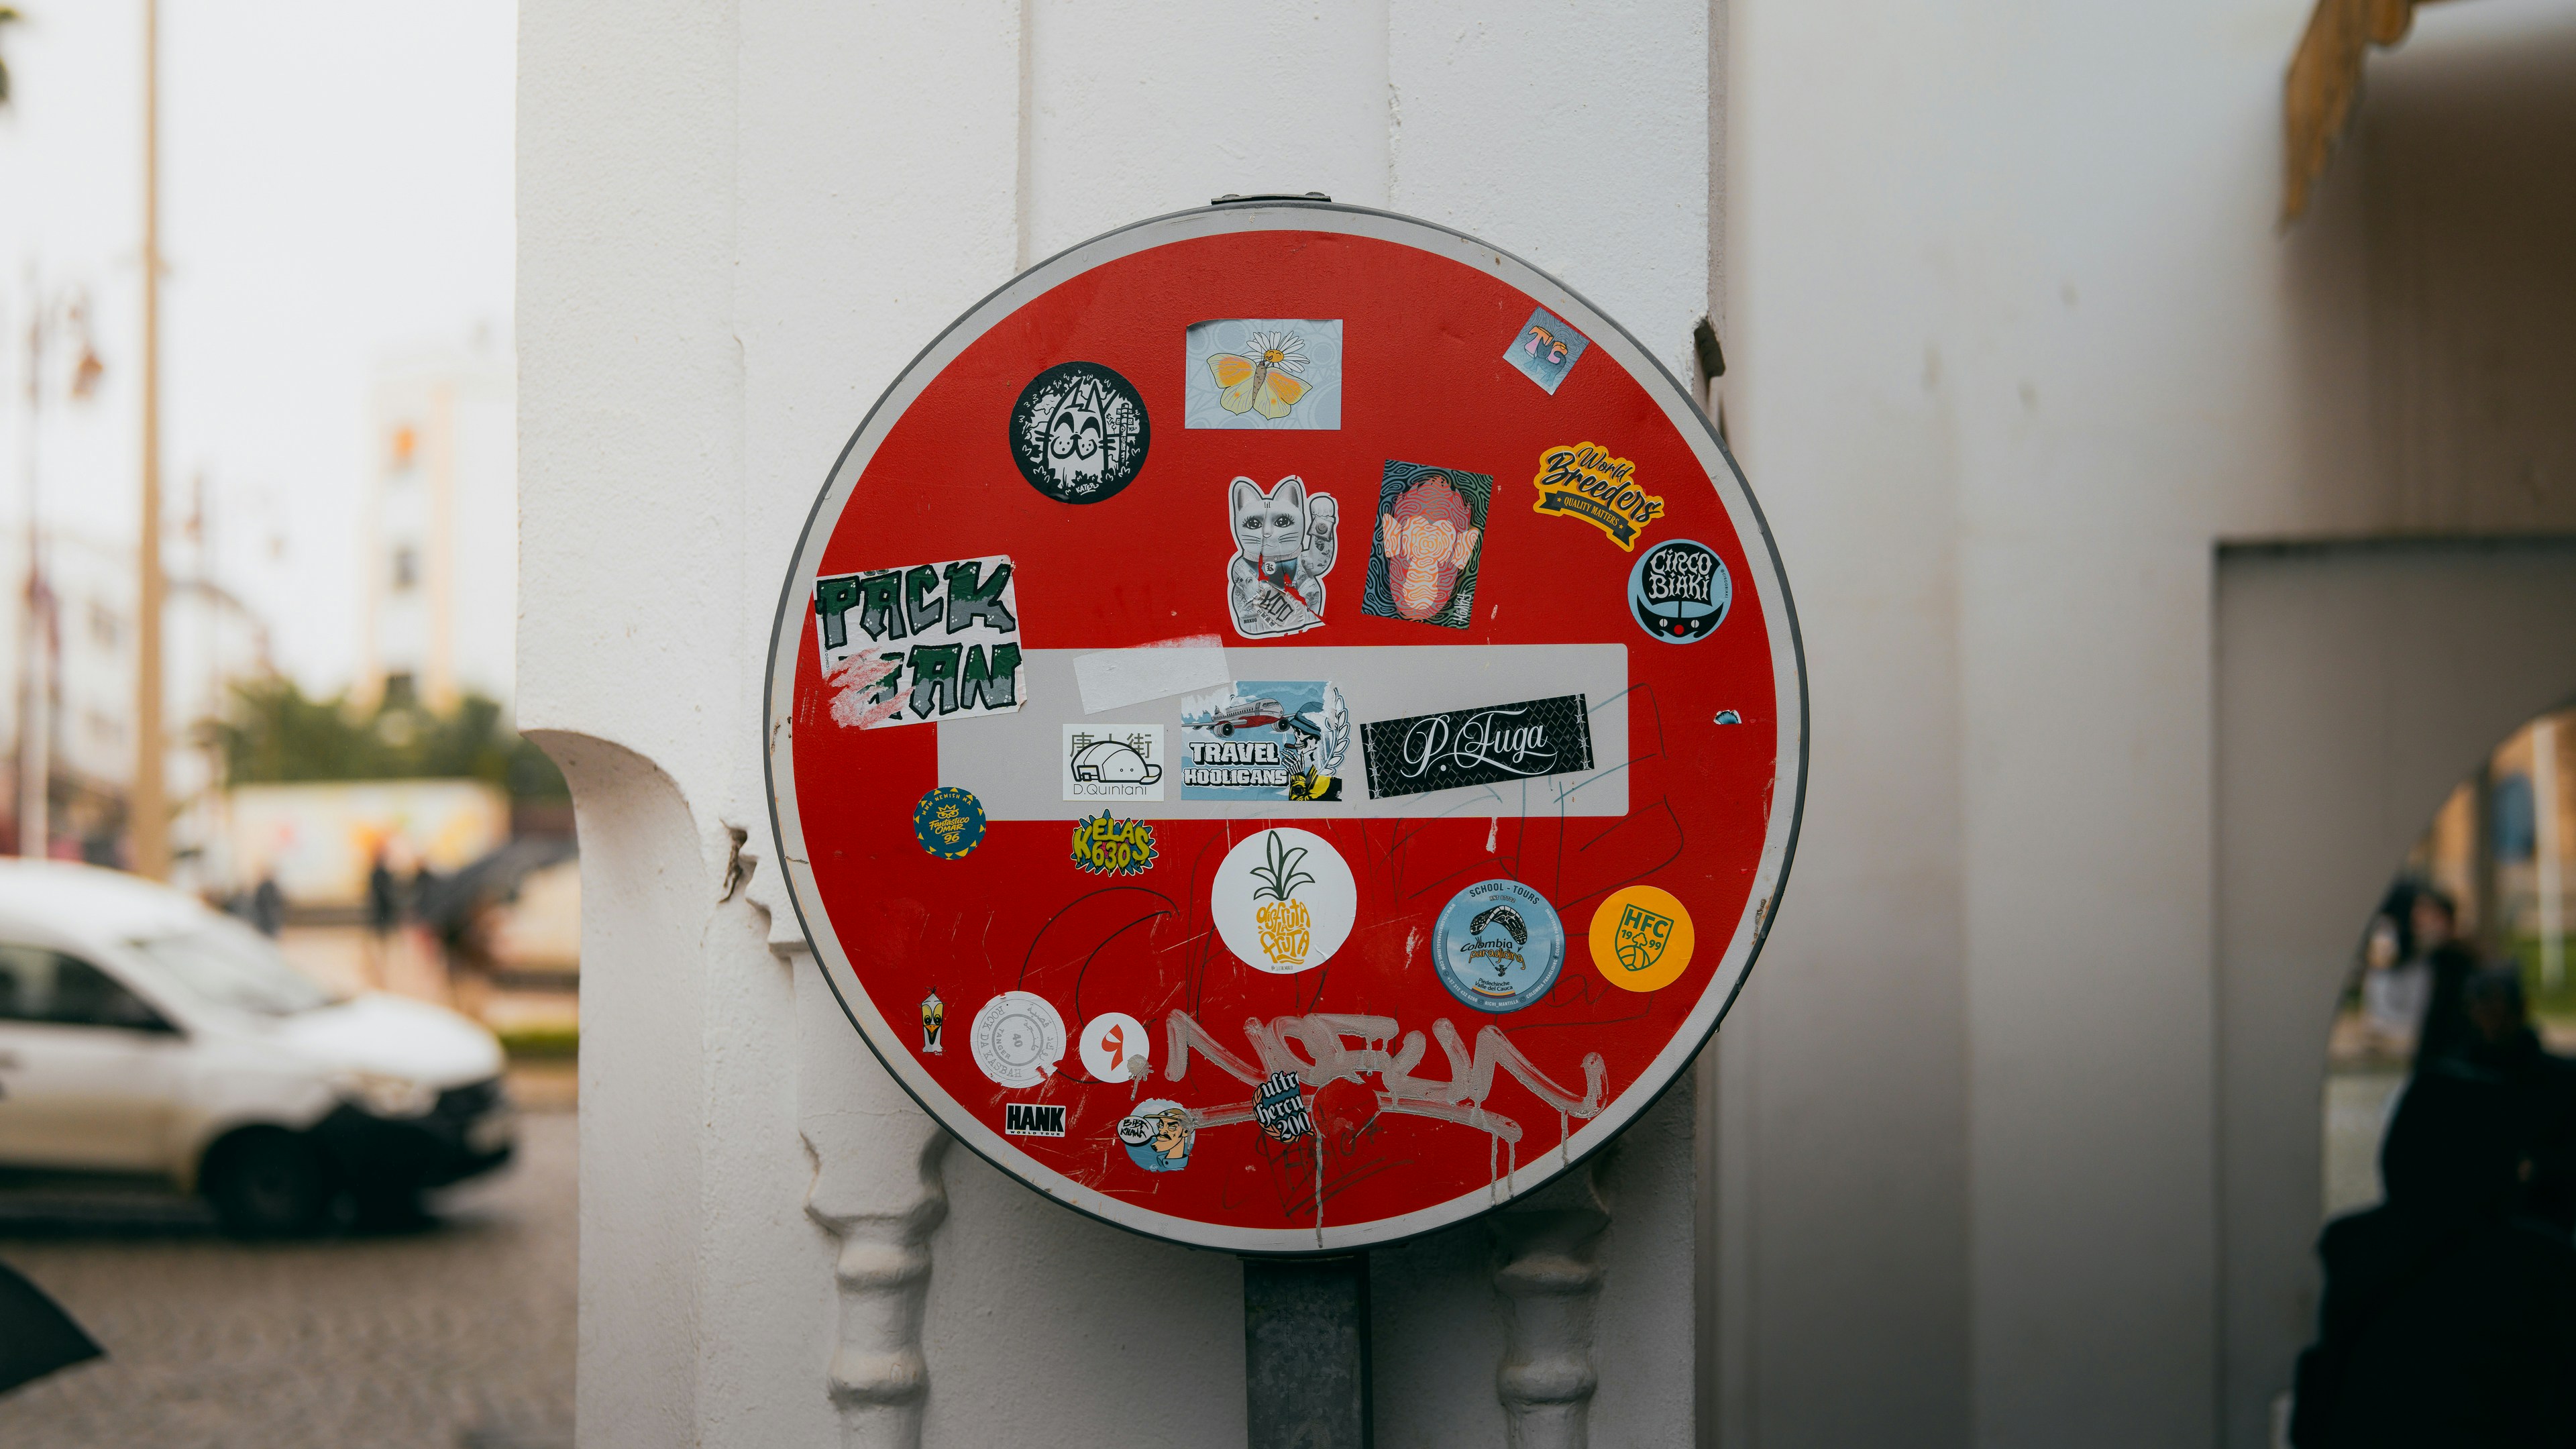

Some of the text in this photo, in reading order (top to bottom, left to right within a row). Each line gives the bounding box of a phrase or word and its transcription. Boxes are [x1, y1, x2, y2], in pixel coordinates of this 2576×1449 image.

[1577, 447, 1633, 482] World
[1540, 451, 1662, 523] Breeders
[1564, 496, 1620, 527] QUALITY MATTERS
[1189, 742, 1280, 765] TRAVEL
[1183, 768, 1289, 786] HOOLIGANS
[1073, 784, 1146, 795] D.Quintani
[934, 824, 966, 835] OMAR
[944, 833, 960, 843] 96
[1073, 817, 1150, 865] KELAS
[1091, 841, 1131, 869] 630
[1469, 882, 1504, 898] SCHOOL
[1513, 885, 1540, 905] TOURS
[1623, 908, 1669, 938] HFC
[1460, 938, 1513, 952] Colombia
[1621, 929, 1662, 951] 19 99
[1468, 947, 1526, 971] paragliding
[1475, 981, 1487, 989] Valle
[1525, 983, 1545, 1000] COLOMBIA
[980, 1006, 1022, 1078] ROCK DA KASBAH
[996, 1028, 1011, 1060] TANGER
[1012, 1033, 1023, 1048] 40
[1007, 1105, 1065, 1132] HANK
